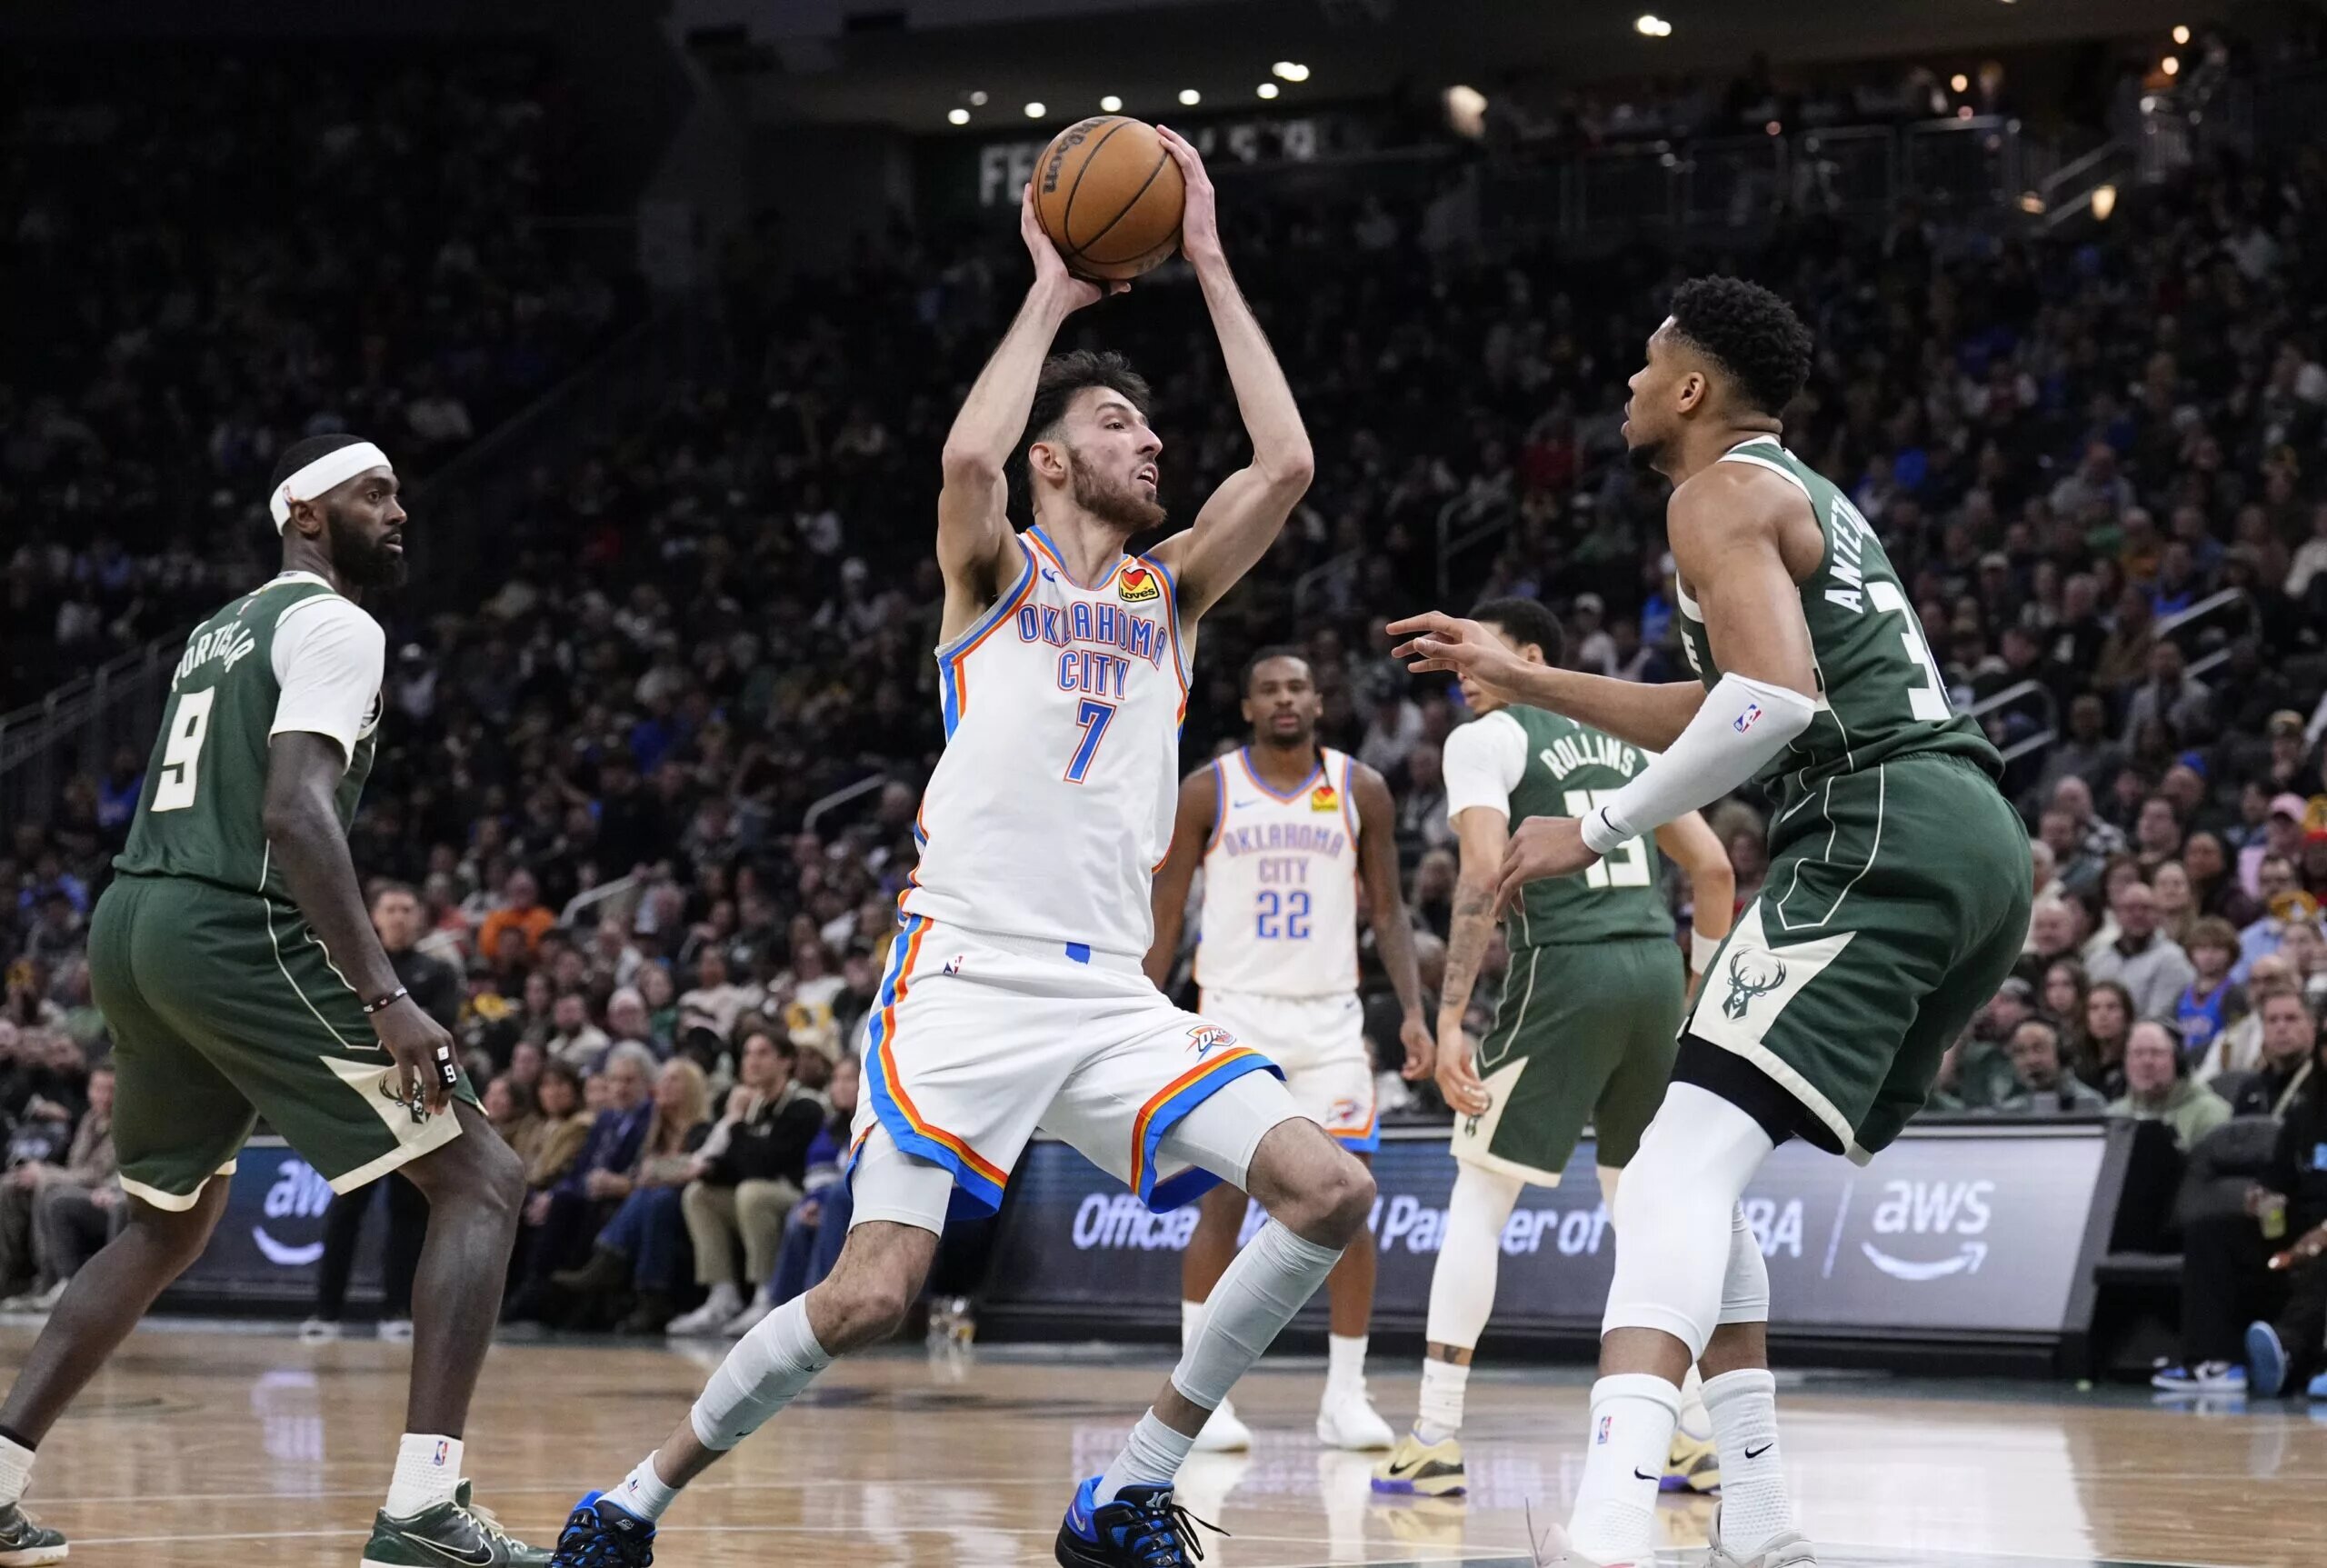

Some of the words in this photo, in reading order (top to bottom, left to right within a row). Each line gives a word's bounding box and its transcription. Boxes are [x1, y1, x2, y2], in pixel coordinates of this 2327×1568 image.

[1016, 602, 1168, 671] OKLAHOMA
[1058, 649, 1130, 701] CITY
[150, 685, 215, 812] 9
[1063, 697, 1117, 784] 7
[1539, 733, 1636, 780] ROLLINS
[1224, 823, 1344, 857] OKLAHOMA
[1259, 857, 1310, 884] CITY
[1256, 889, 1312, 940] 22
[444, 1064, 457, 1083] 9
[265, 1159, 335, 1218] aw
[1873, 1180, 1995, 1234] aws
[1073, 1193, 1201, 1251] Officia
[1557, 1202, 1613, 1255] of
[1740, 1197, 1803, 1258] BA
